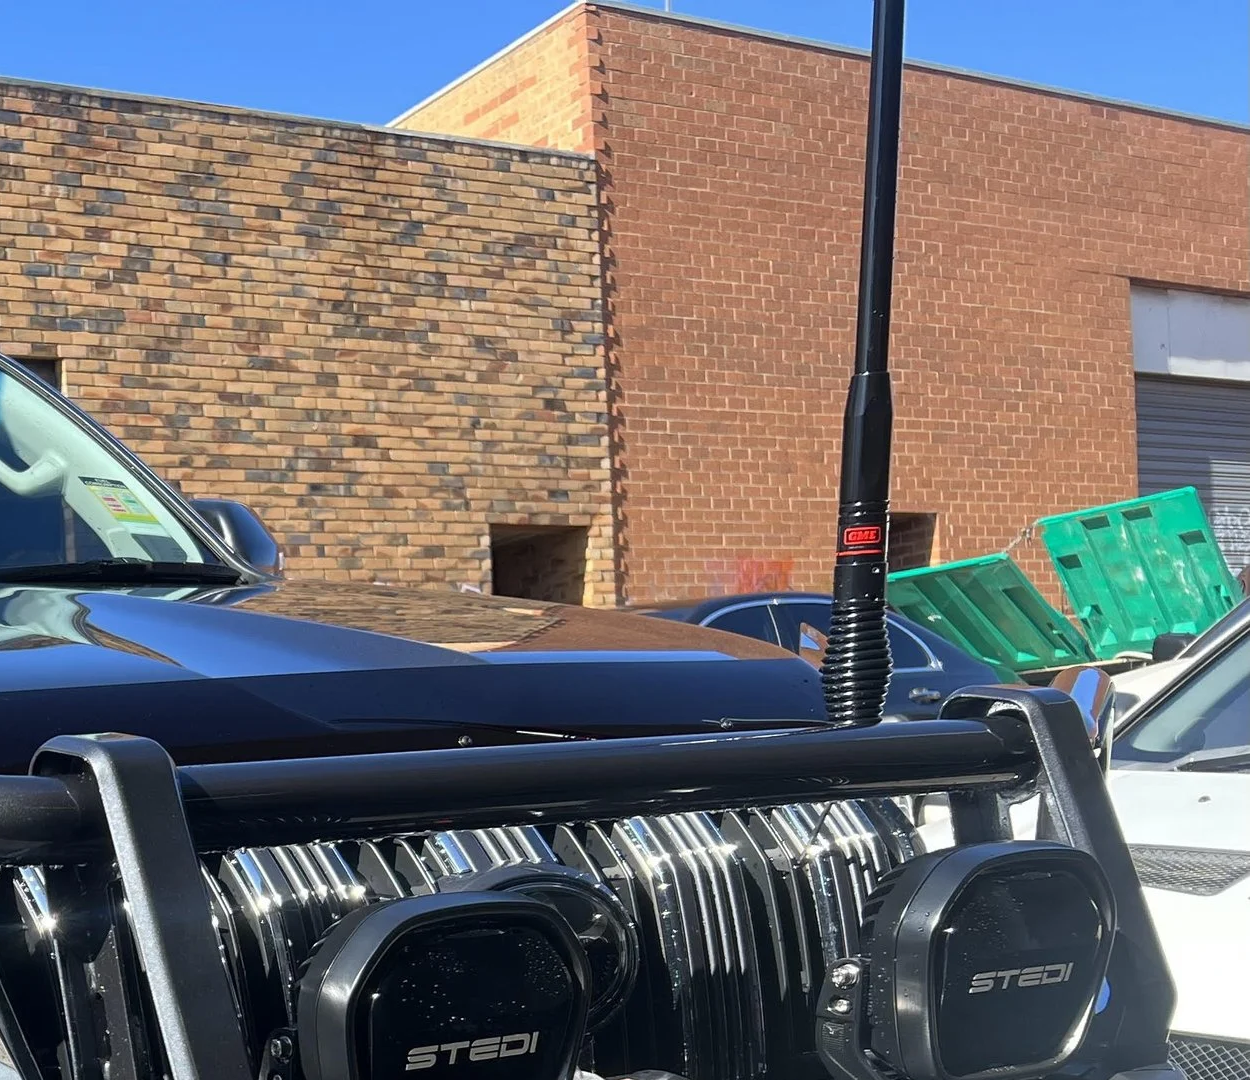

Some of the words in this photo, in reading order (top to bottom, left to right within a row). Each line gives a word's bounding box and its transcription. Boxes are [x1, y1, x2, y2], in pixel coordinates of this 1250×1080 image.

[848, 530, 877, 541] GME
[969, 962, 1074, 993] STEDI
[405, 1031, 540, 1071] STEDI
